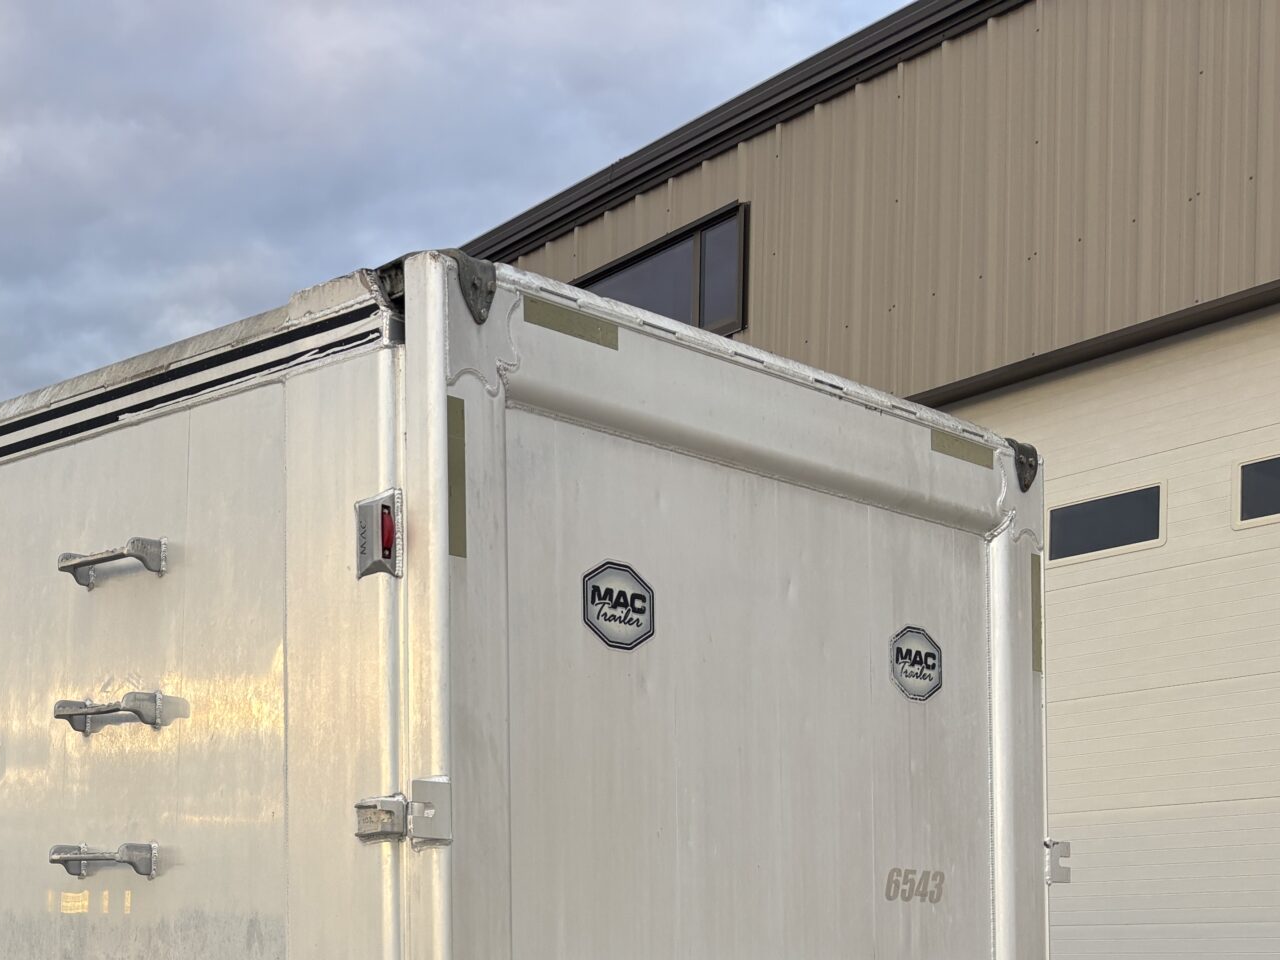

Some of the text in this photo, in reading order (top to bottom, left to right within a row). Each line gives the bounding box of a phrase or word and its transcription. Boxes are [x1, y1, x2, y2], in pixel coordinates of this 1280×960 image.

[591, 585, 647, 615] MAC
[595, 601, 643, 628] Trailer
[895, 646, 937, 671] MAC
[898, 660, 934, 682] Trailer
[884, 867, 945, 904] 6543
